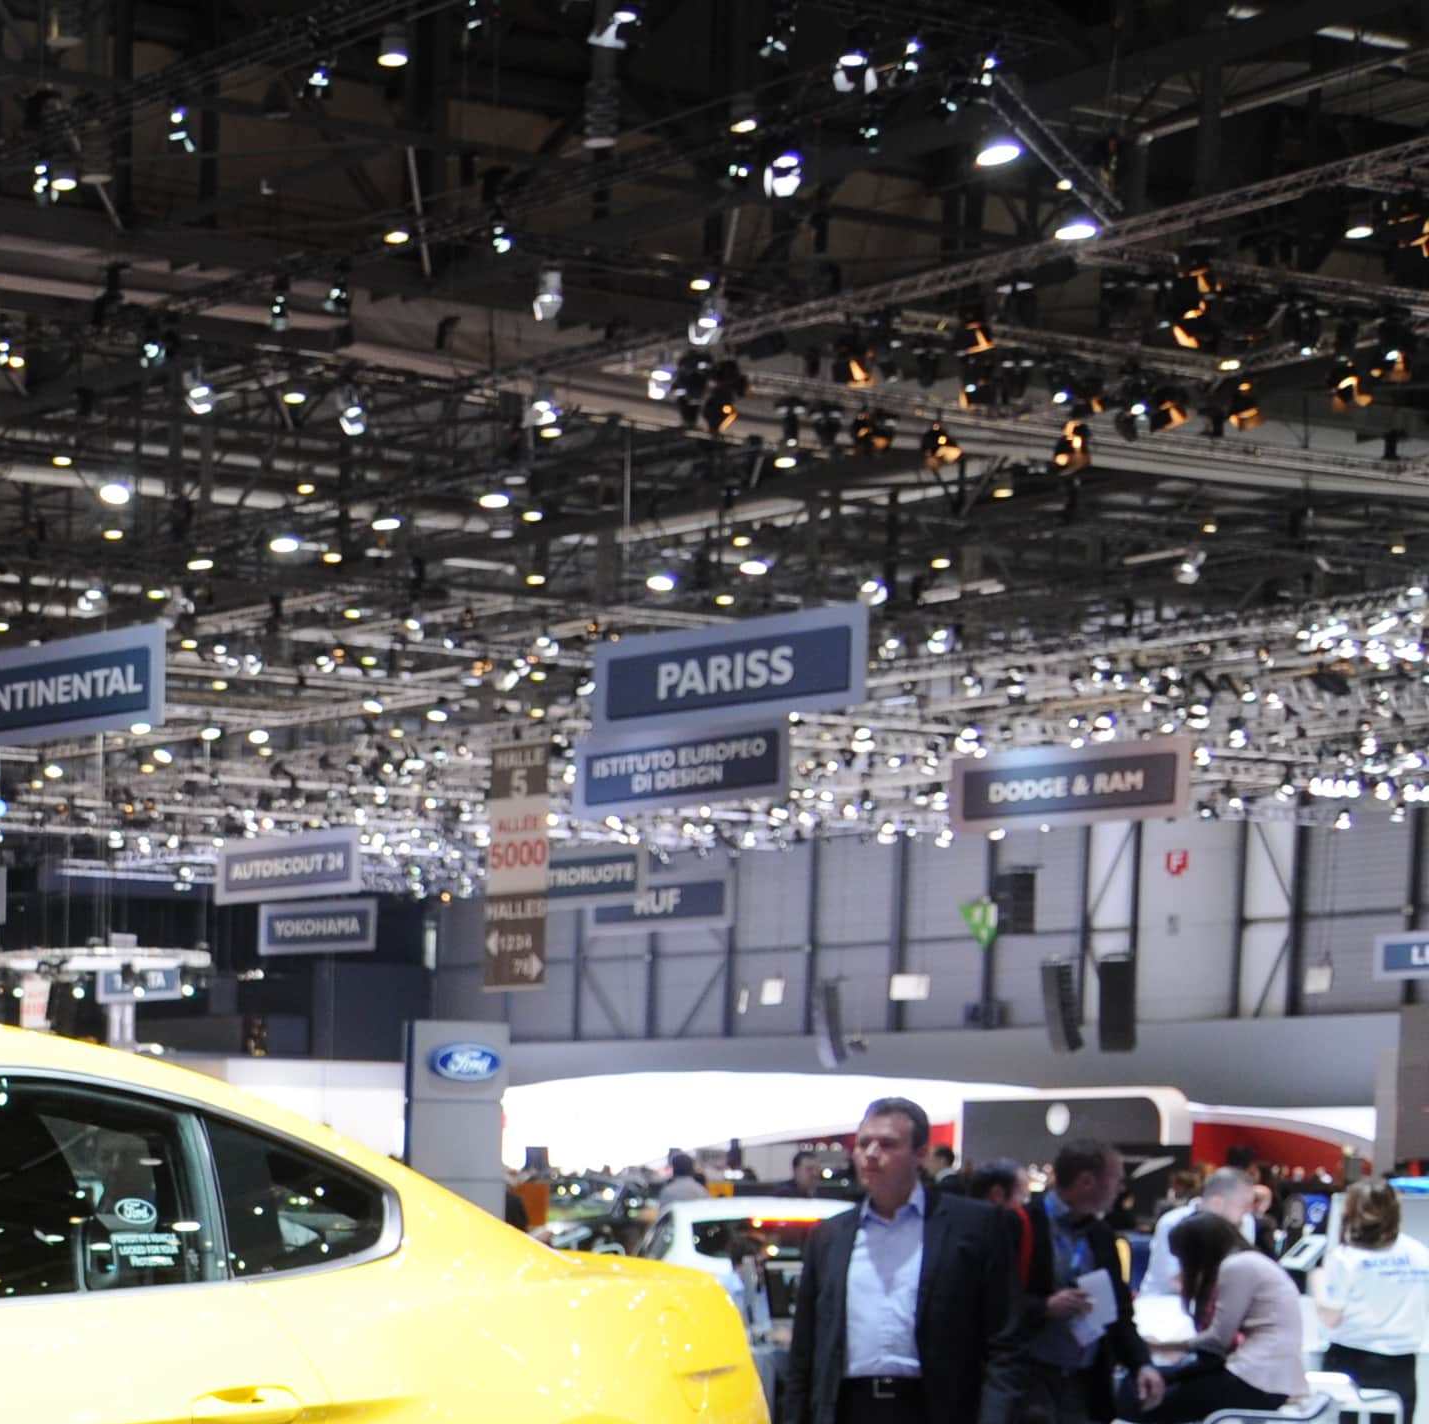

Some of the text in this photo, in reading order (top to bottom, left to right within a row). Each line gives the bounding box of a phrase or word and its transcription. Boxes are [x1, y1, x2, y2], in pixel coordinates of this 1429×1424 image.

[657, 646, 794, 700] PARISS
[493, 748, 547, 769] HALLE
[592, 737, 767, 779] ISTITUTO EUROPEO
[509, 769, 528, 795] 5
[631, 764, 723, 795] DI DESIGN
[988, 769, 1145, 804] DODGE & RAM
[230, 854, 324, 881] AUTOSCOUT
[489, 839, 547, 870] 5000
[273, 917, 360, 937] YOKOHAMA
[447, 1050, 492, 1072] Ford
